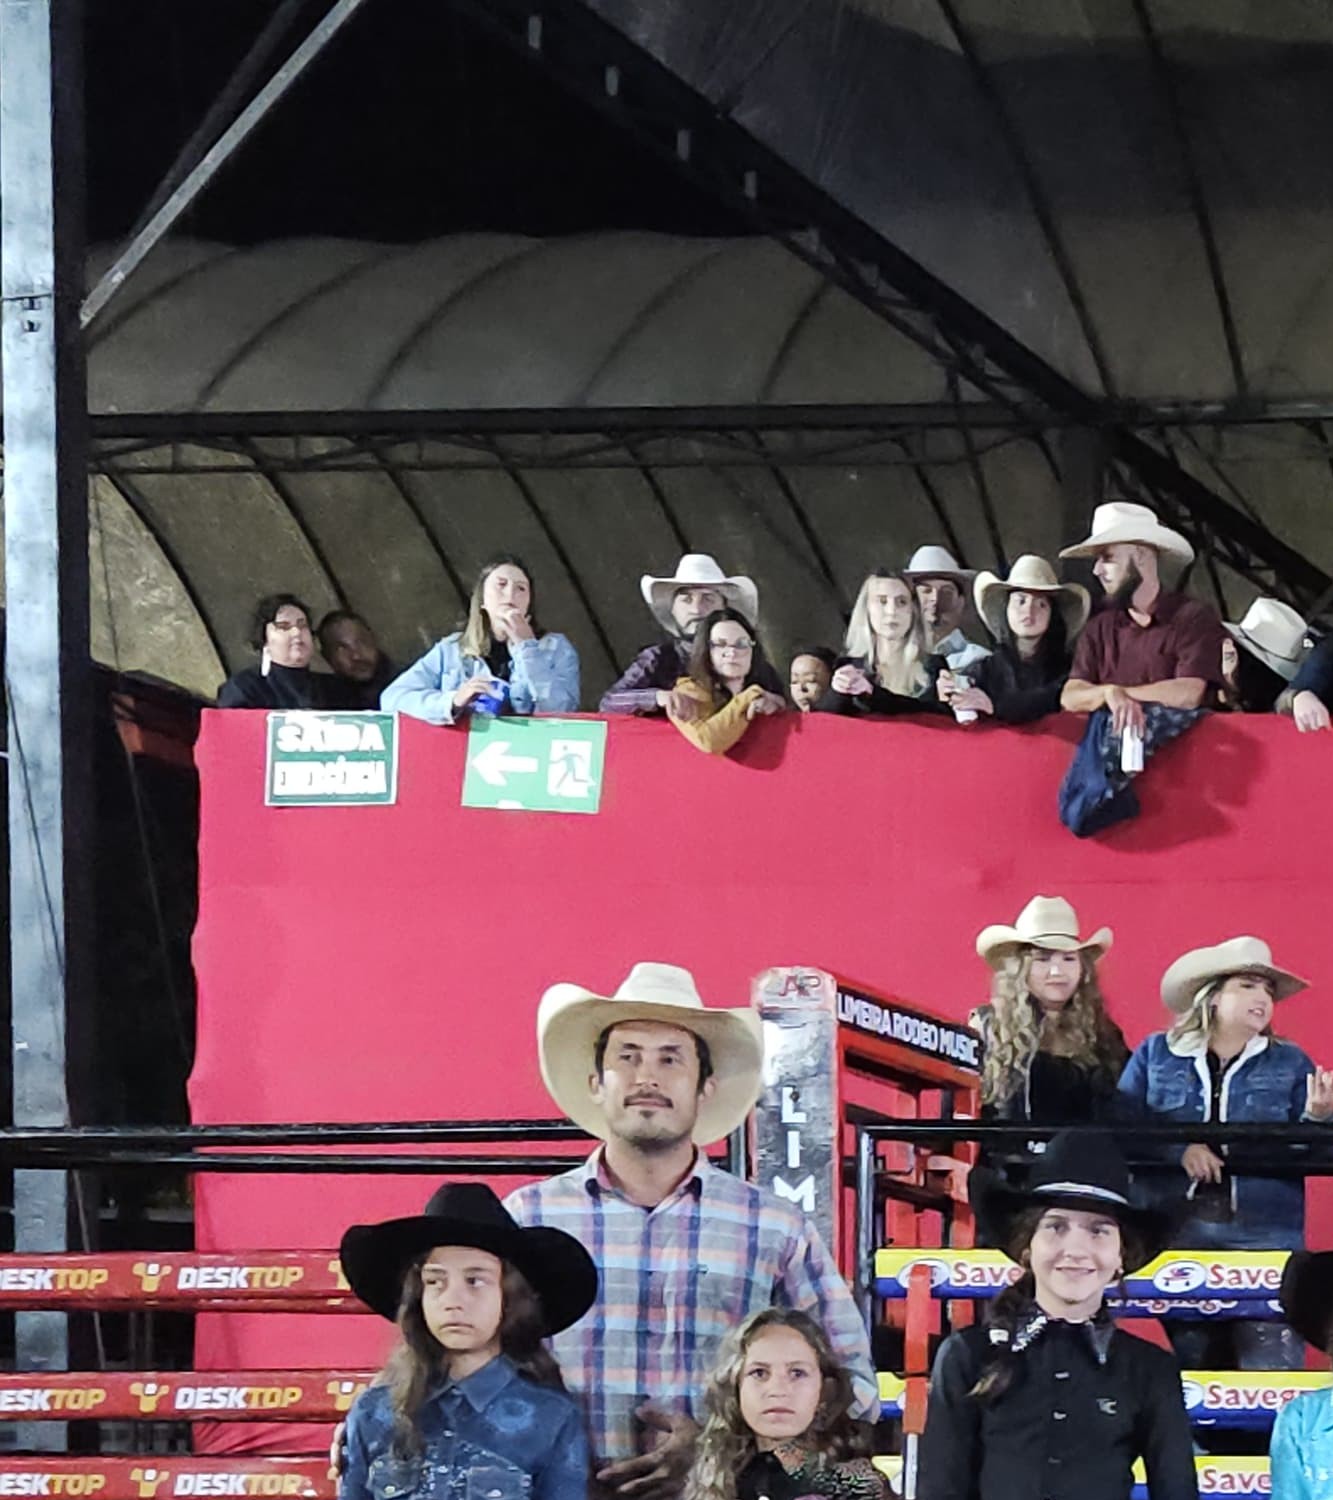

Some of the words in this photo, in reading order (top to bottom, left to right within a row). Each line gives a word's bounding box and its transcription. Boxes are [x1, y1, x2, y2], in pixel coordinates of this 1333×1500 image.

[837, 993, 892, 1036] LIMEIRA
[893, 1012, 938, 1051] RODEO
[939, 1028, 979, 1066] MUSIC
[0, 1267, 108, 1290] ESKTOP
[177, 1267, 304, 1290] DESKTOP
[0, 1388, 106, 1411] ESKTOP
[175, 1388, 302, 1411] DESKTOP
[0, 1473, 105, 1495] ESKTOP
[174, 1473, 300, 1495] DESKTOP
